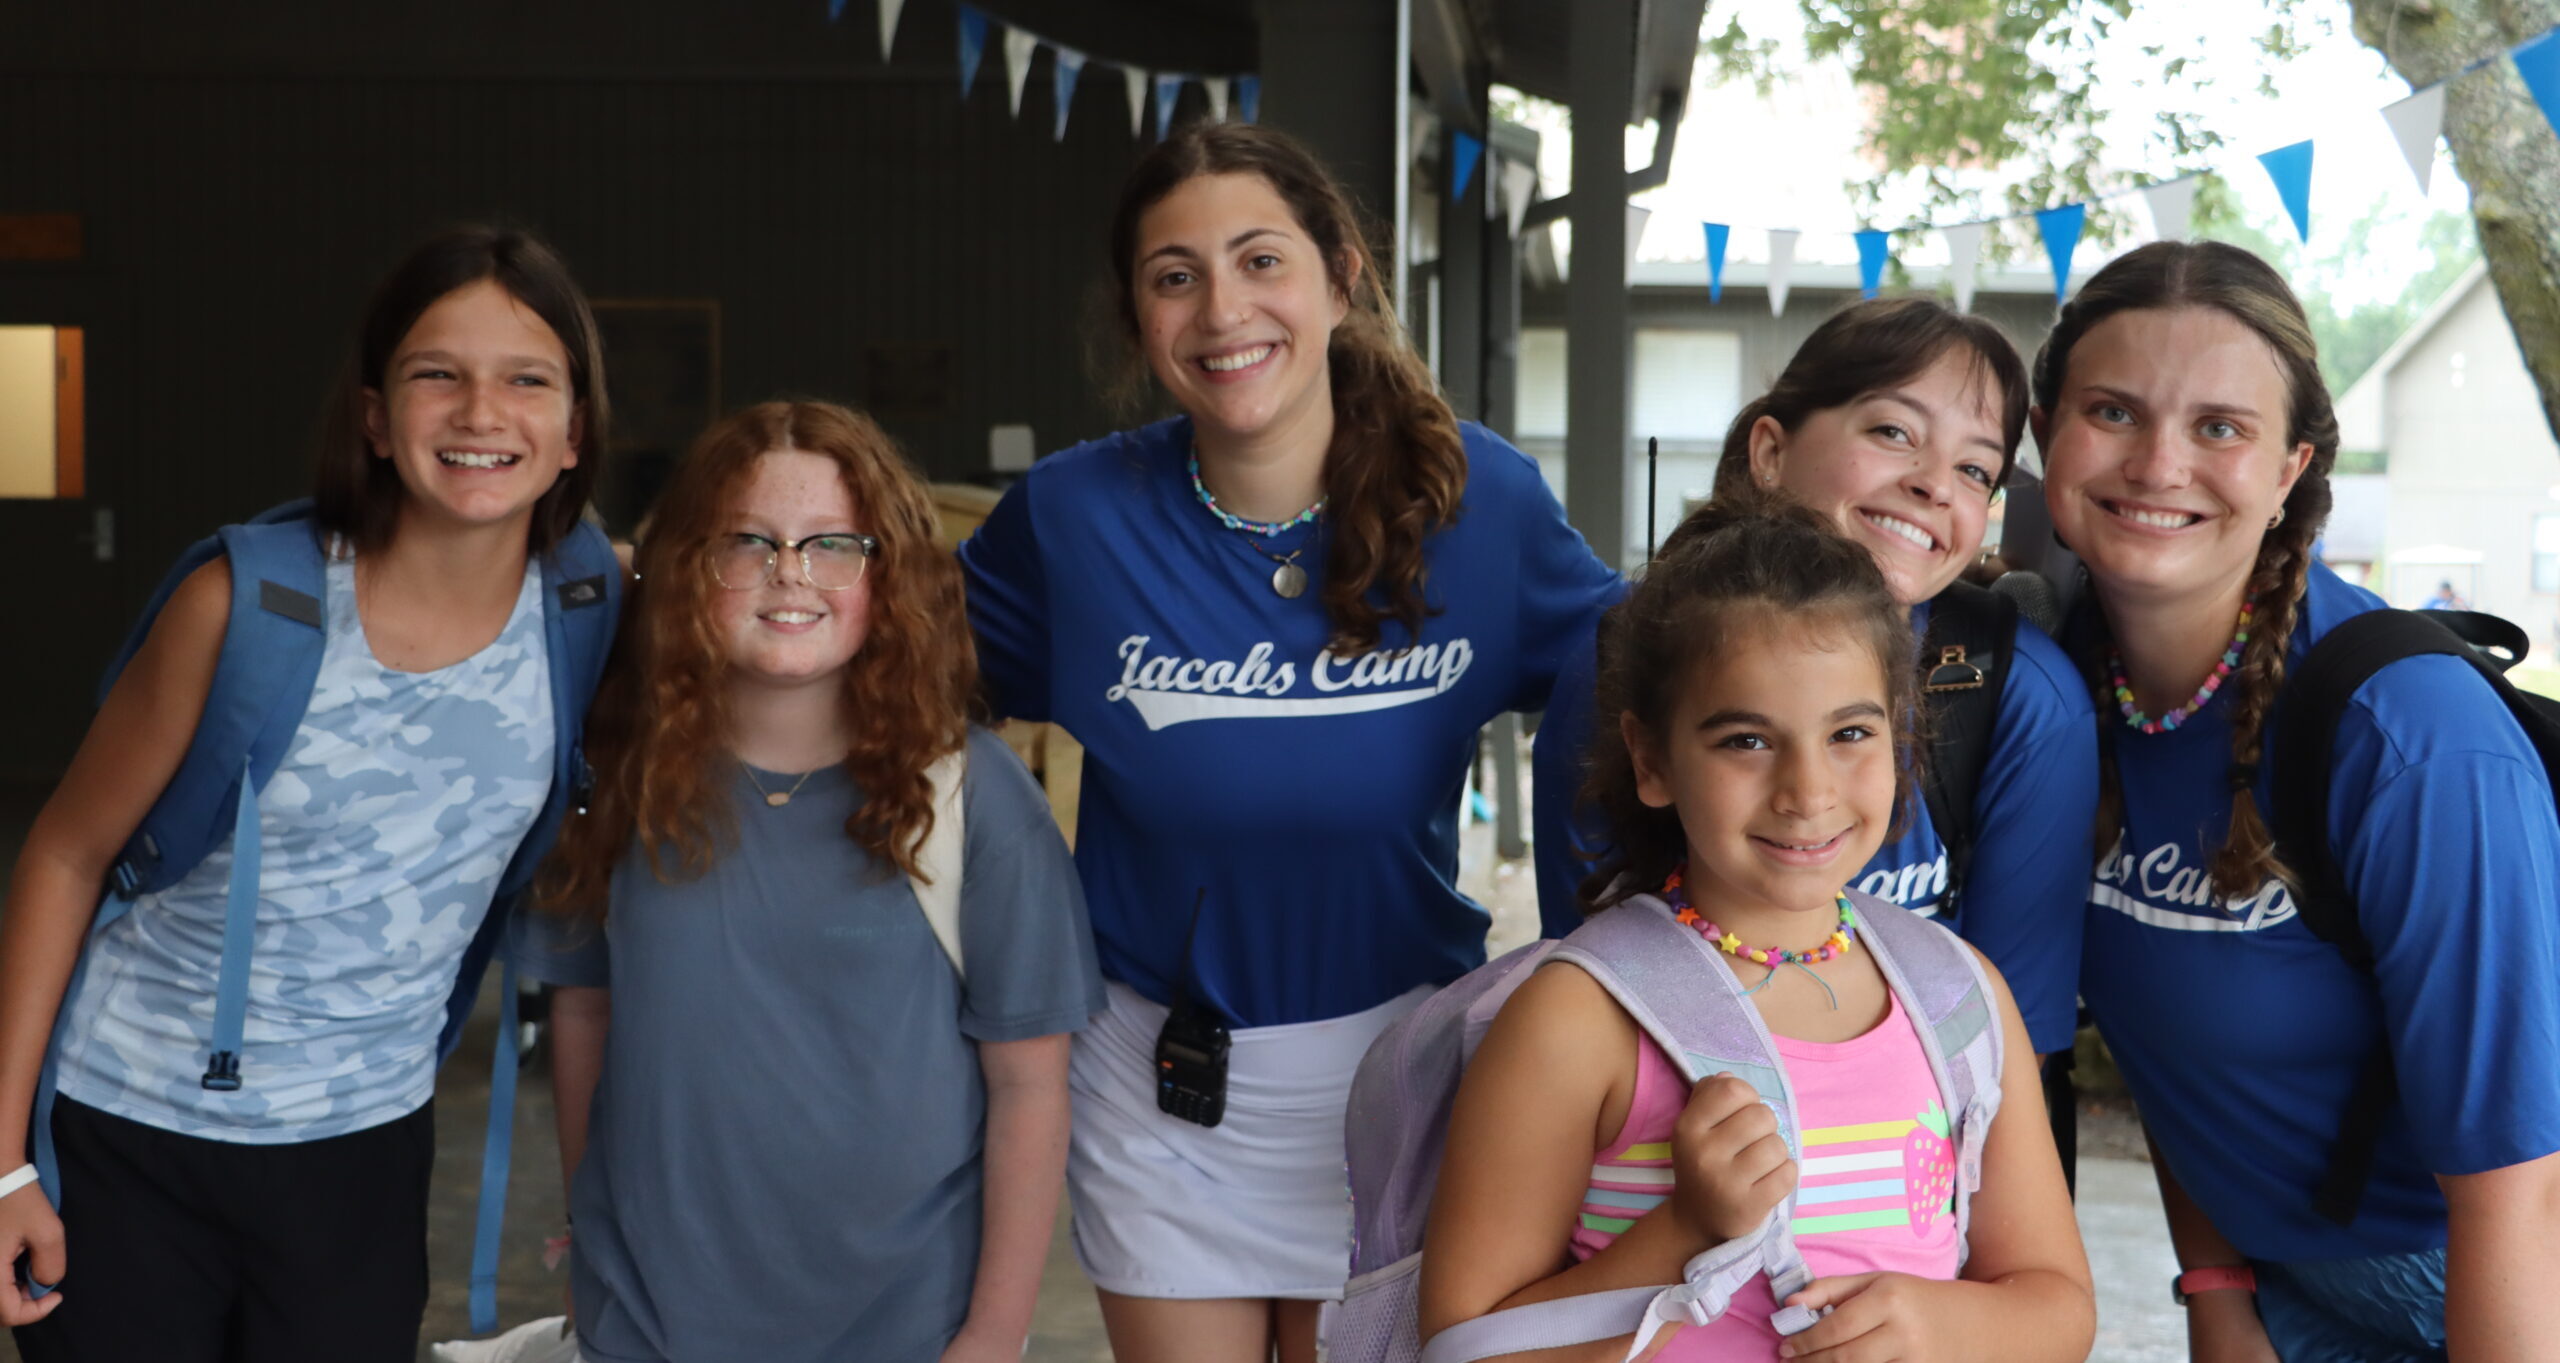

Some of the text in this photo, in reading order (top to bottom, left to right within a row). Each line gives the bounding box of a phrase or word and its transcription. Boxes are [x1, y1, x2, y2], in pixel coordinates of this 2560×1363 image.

[1106, 635, 1474, 702] Jacobs Camp
[1857, 850, 1947, 905] am
